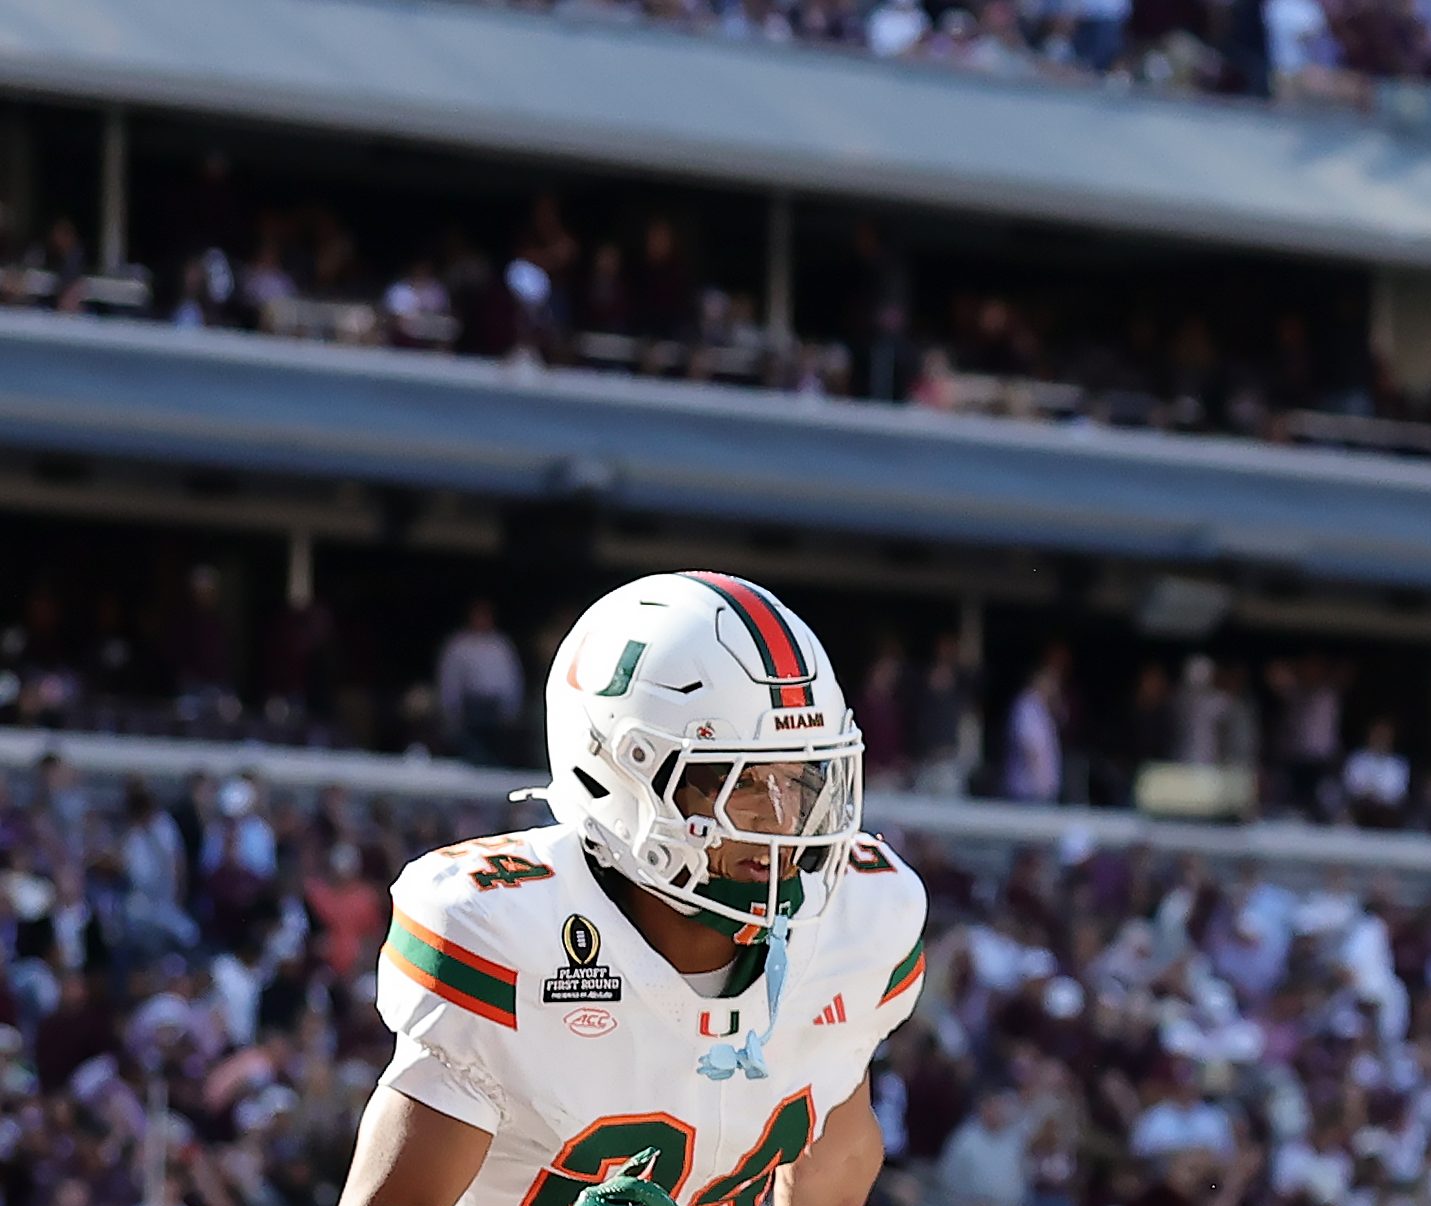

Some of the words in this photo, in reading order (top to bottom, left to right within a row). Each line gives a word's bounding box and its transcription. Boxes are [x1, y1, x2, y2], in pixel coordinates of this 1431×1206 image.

[775, 712, 824, 731] MIAMI
[559, 968, 608, 980] PLAYOFF
[547, 979, 580, 991] FIRST
[581, 978, 619, 990] ROUND
[571, 1013, 608, 1028] ACC
[699, 1010, 740, 1038] U
